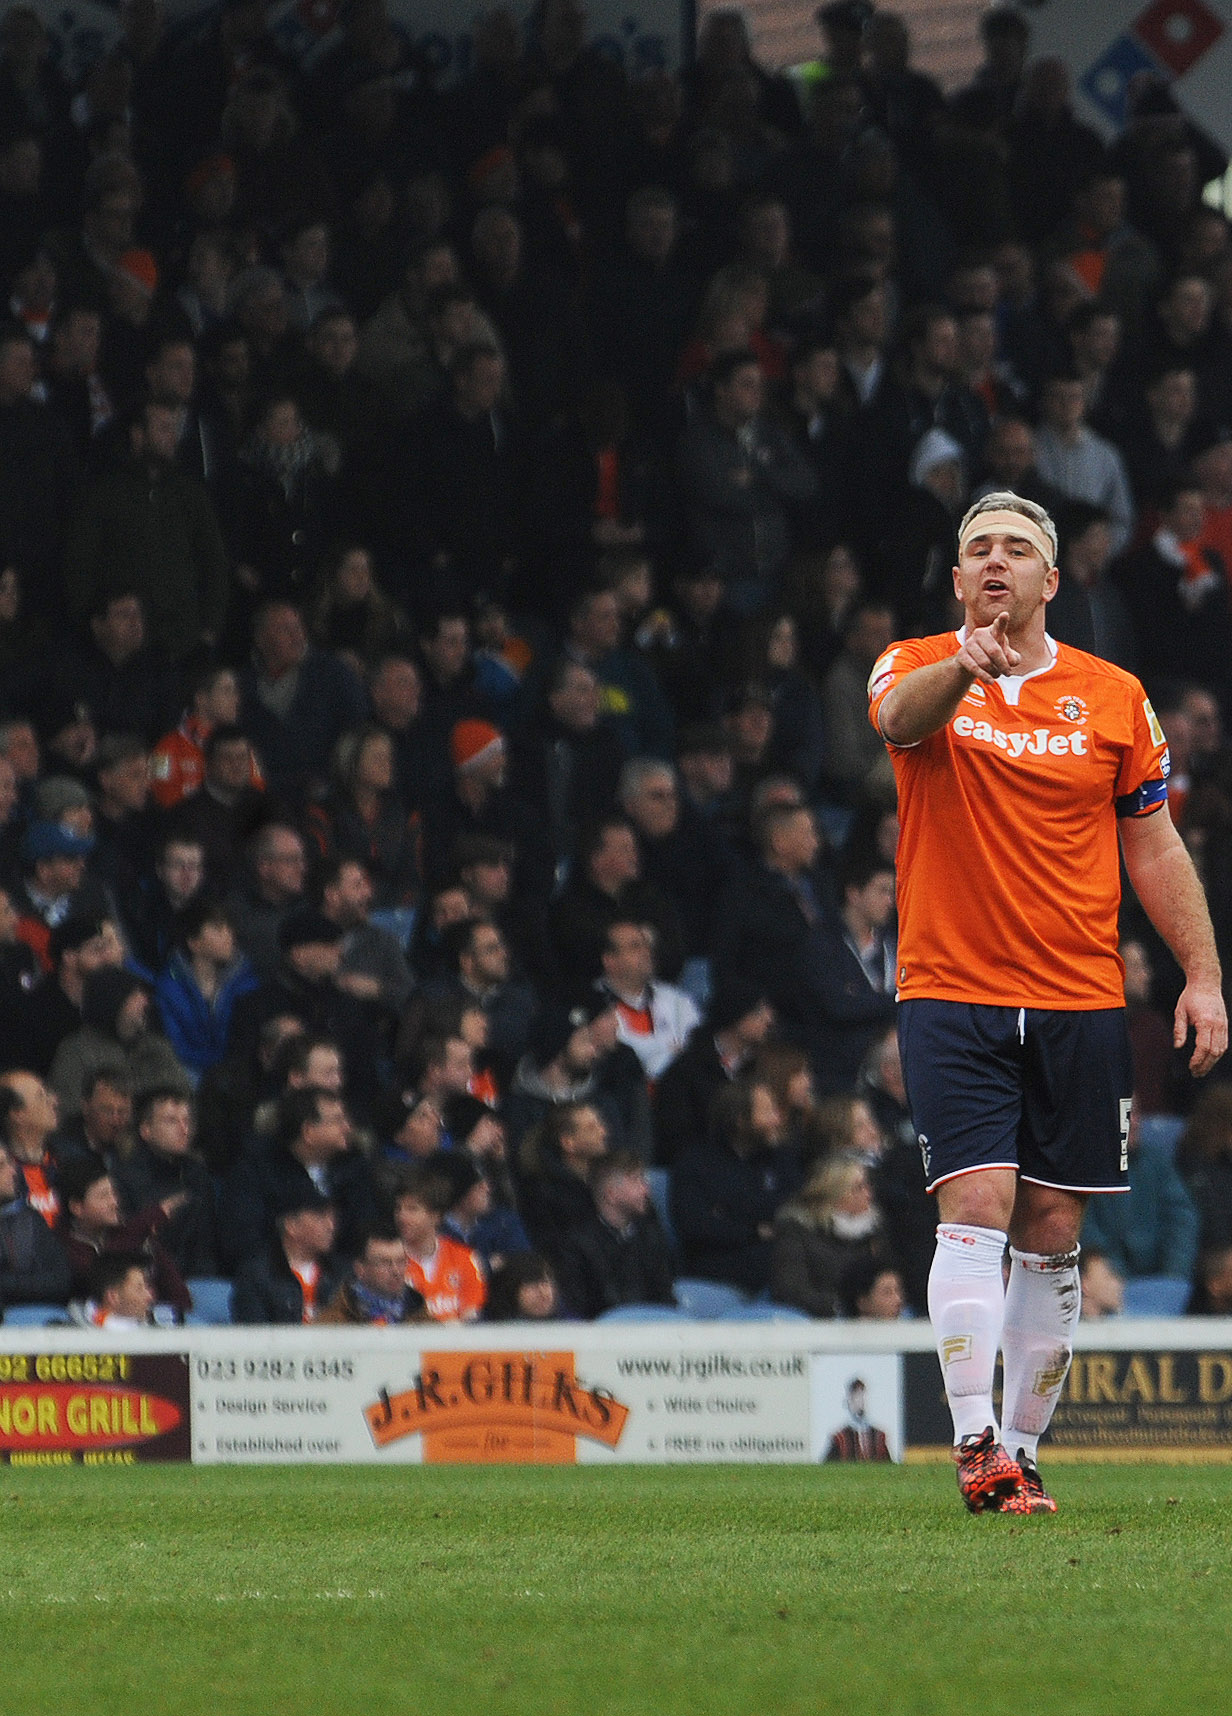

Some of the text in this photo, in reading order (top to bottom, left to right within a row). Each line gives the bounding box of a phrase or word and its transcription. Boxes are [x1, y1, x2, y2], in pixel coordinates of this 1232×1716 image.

[953, 715, 1088, 757] easyJet
[197, 1357, 237, 1381] 023
[616, 1353, 805, 1383] www.jrgilks.co.uk
[1060, 1353, 1188, 1402] IRAL
[66, 1395, 158, 1436] GRILL
[215, 1397, 328, 1418] Design Service
[663, 1396, 758, 1415] Wide Choice
[664, 1435, 702, 1451] FREE
